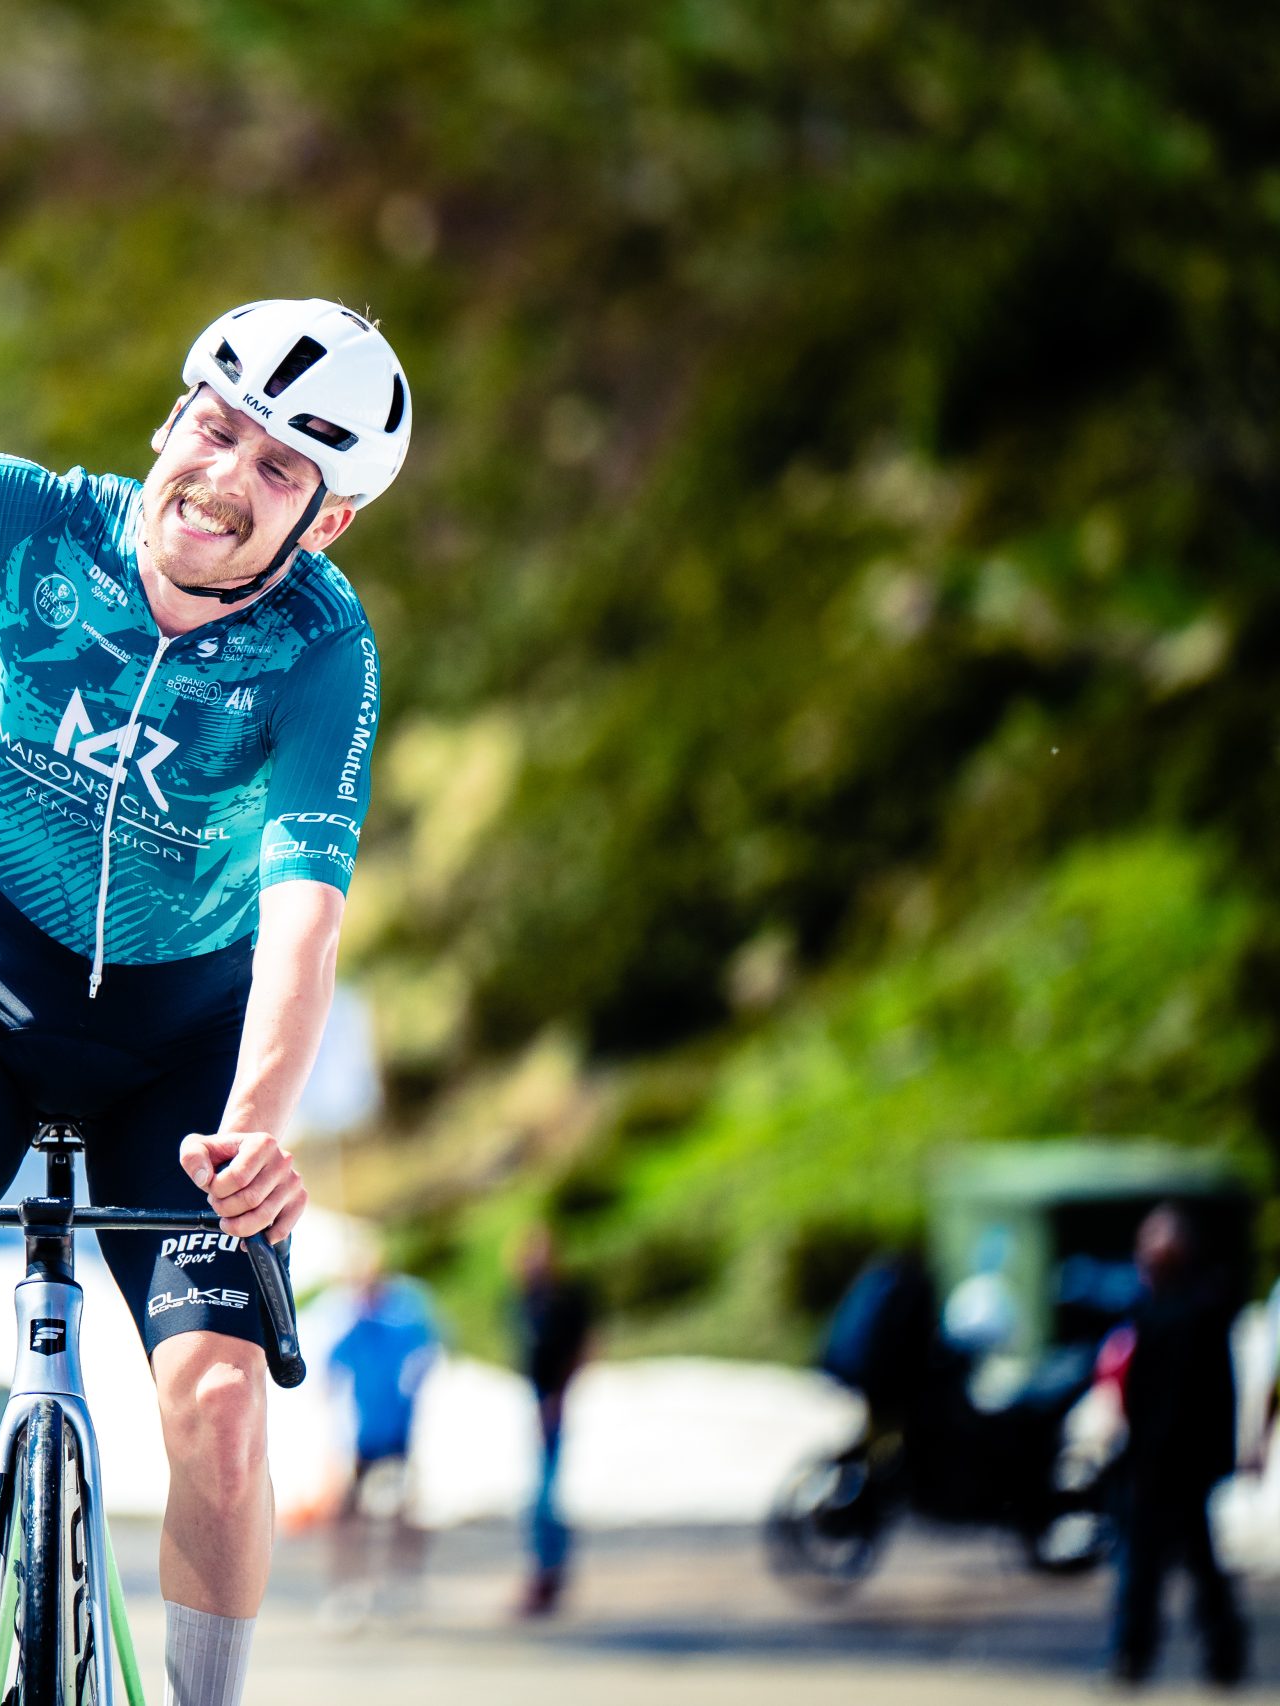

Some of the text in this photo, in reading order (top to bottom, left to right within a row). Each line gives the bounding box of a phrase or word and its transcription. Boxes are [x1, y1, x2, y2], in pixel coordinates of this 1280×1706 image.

[243, 393, 273, 419] KASK
[88, 564, 129, 607] DIFFU
[91, 585, 116, 608] Sport
[38, 596, 64, 622] BLEU
[40, 583, 73, 619] BRESSE
[227, 636, 246, 645] UCI
[220, 653, 244, 662] TEAM
[166, 679, 204, 699] BOURG
[175, 674, 207, 689] GRAND
[224, 687, 255, 712] AIN
[336, 637, 378, 803] Crédit Mutuel
[93, 802, 105, 817] &
[120, 794, 231, 841] CHANEL
[25, 786, 181, 863] RÉNOVATION
[265, 840, 356, 874] DUKE
[160, 1233, 240, 1258] DIFFU
[174, 1251, 217, 1268] Sport
[148, 1287, 250, 1315] DUKE
[188, 1299, 244, 1309] WHEELS
